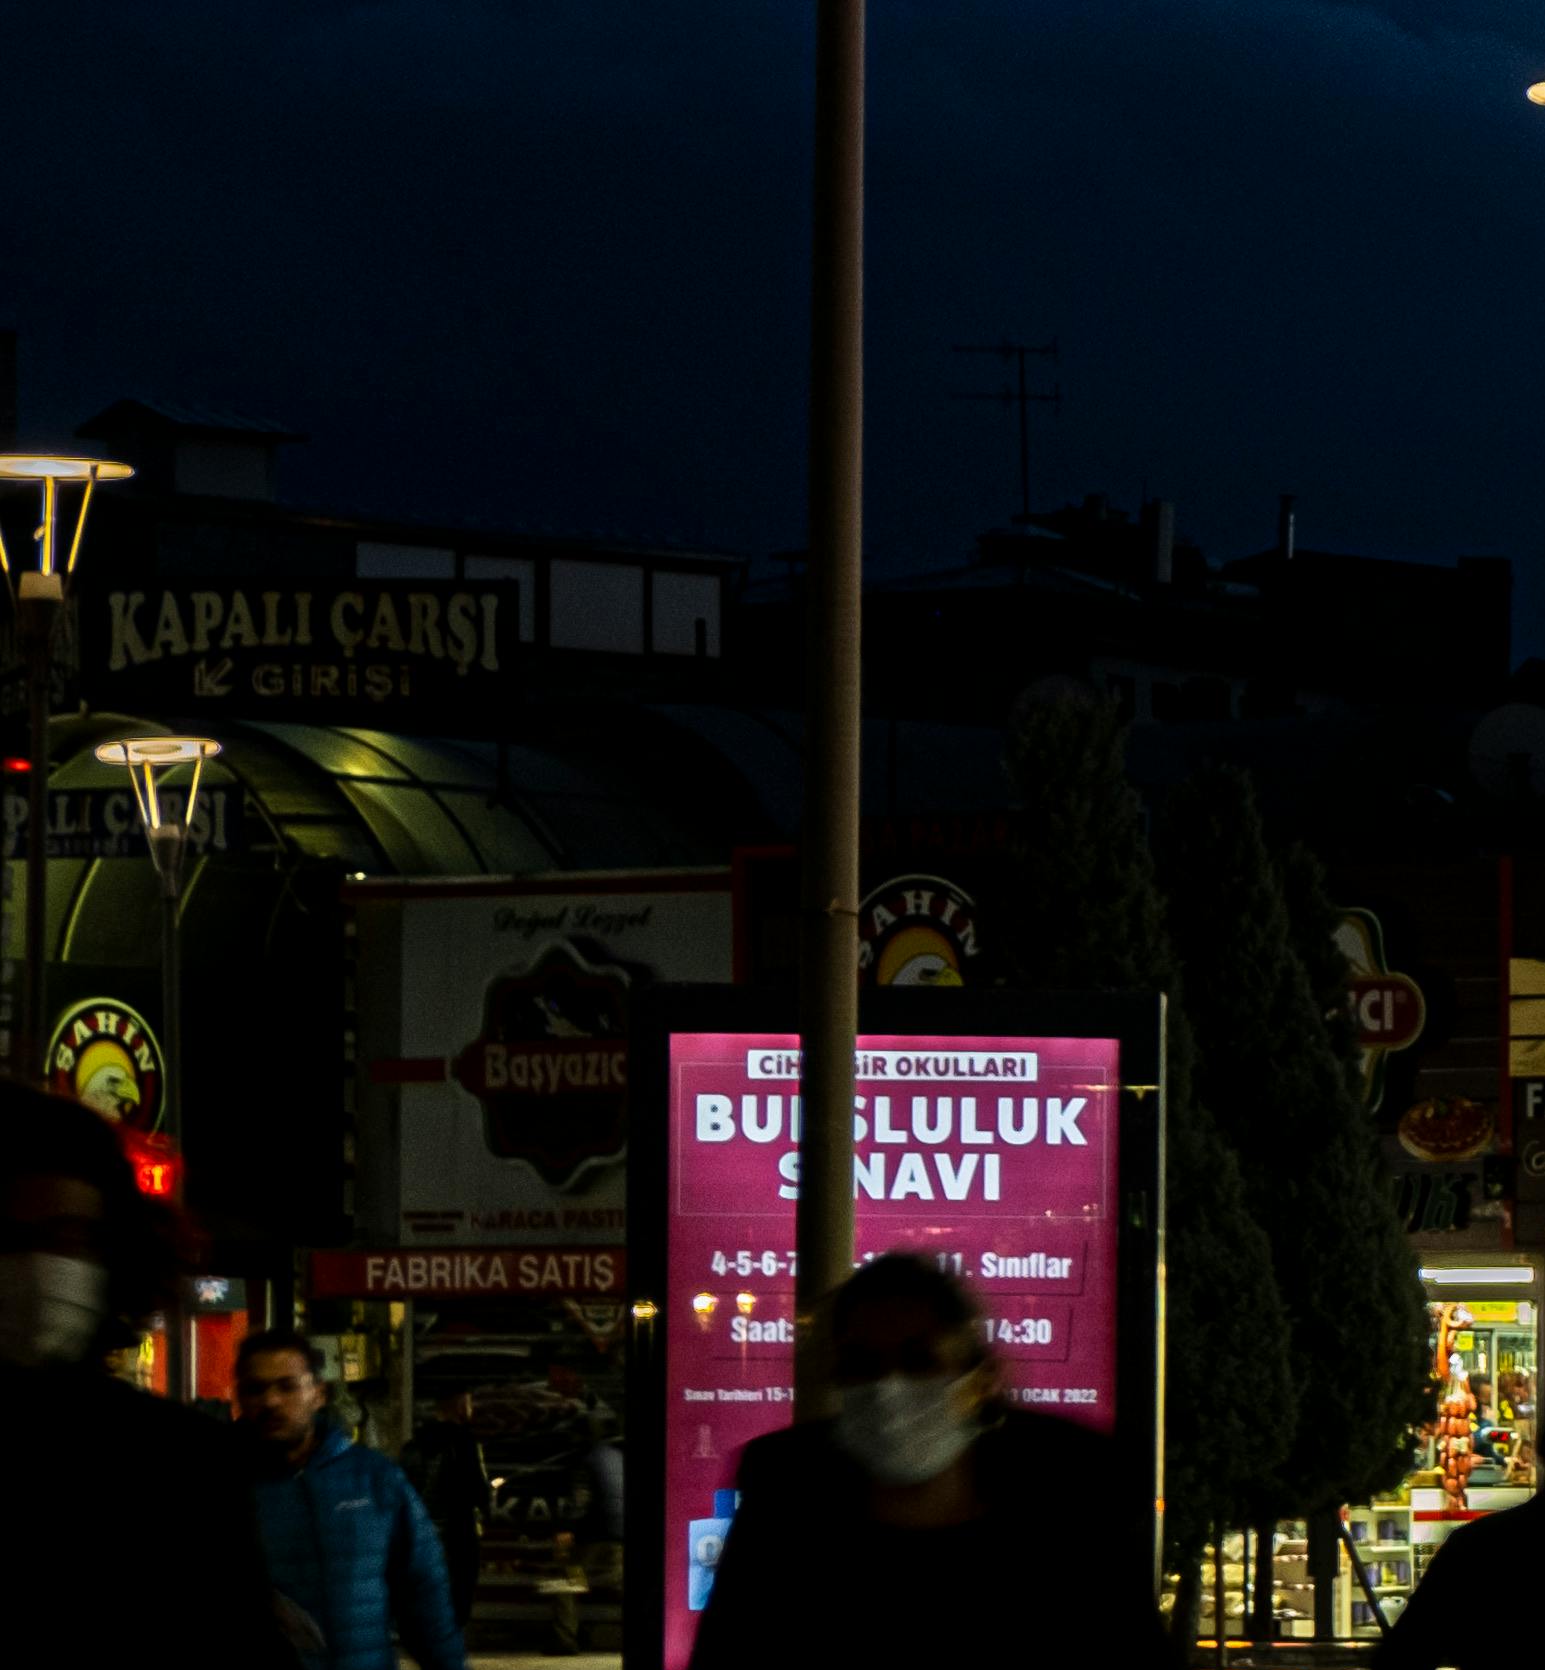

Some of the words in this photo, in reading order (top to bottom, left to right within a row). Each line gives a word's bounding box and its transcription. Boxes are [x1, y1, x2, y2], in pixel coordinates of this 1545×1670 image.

[108, 590, 313, 672] KAPALI
[329, 590, 500, 677] ÇARŞI
[484, 1043, 627, 1095] Başyazıc
[895, 1056, 1028, 1078] OKULLARI
[695, 1094, 1088, 1145] BULULUK
[777, 1152, 1002, 1201] SNAVI
[981, 1251, 1073, 1279] Sınıflar
[730, 1316, 795, 1344] Saat:
[984, 1316, 1052, 1344] 14:30
